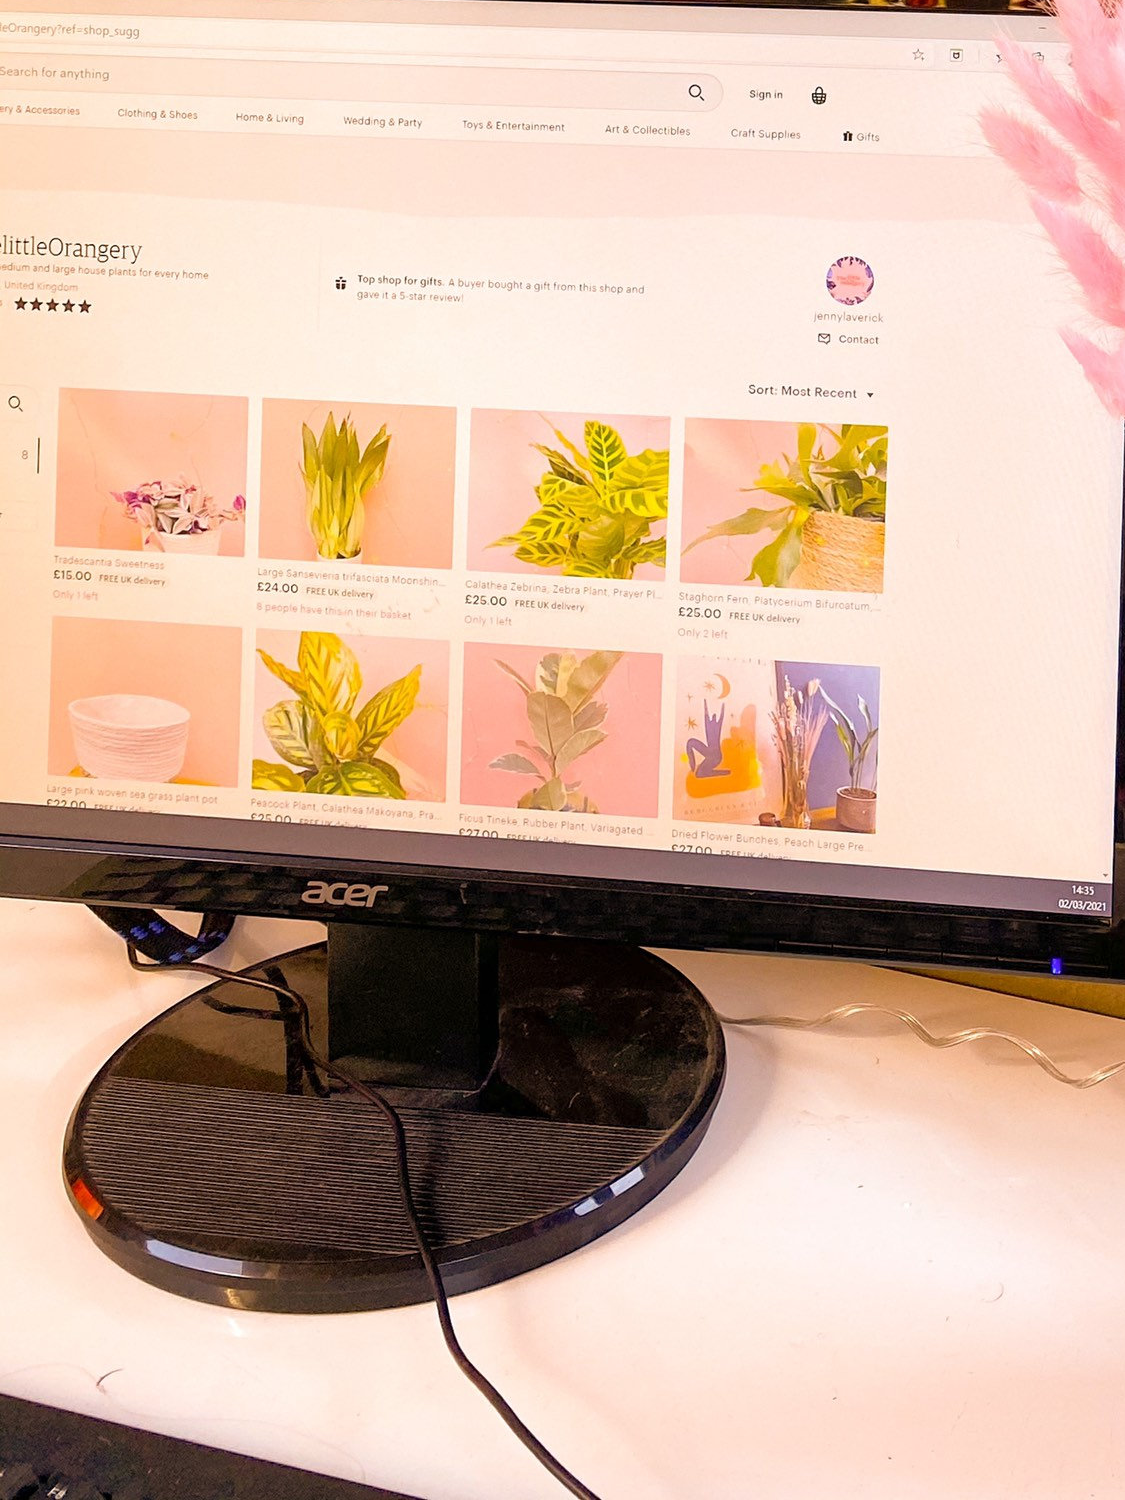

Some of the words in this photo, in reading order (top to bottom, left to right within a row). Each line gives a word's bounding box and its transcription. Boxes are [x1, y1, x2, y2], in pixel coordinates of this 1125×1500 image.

[0, 66, 38, 77] Search
[41, 67, 57, 78] for
[60, 68, 110, 81] anything
[749, 89, 772, 100] Sign
[774, 89, 784, 99] in
[16, 105, 22, 114] &
[25, 105, 80, 116] Accessories
[117, 108, 158, 121] Clothing
[160, 110, 167, 119] &
[169, 110, 199, 120] Shoes
[235, 112, 265, 122] Home
[266, 113, 273, 122] &
[276, 114, 305, 126] Living
[343, 116, 386, 128] Wedding
[388, 118, 395, 127] &
[398, 118, 423, 129] Party
[463, 120, 484, 131] Toys
[486, 121, 493, 131] &
[496, 121, 566, 132] Entertainment
[605, 124, 620, 134] Art
[622, 125, 629, 134] &
[632, 124, 691, 136] Collectibles
[731, 128, 756, 139] Craft
[758, 129, 801, 141] Supplies
[857, 132, 881, 143] Gifts
[0, 235, 143, 264] littleOrangery
[33, 263, 50, 273] and
[52, 263, 76, 275] large
[78, 265, 106, 275] house
[108, 267, 137, 278] plants
[139, 268, 152, 277] for
[154, 270, 180, 280] every
[182, 269, 210, 280] home
[4, 280, 35, 291] United
[37, 282, 79, 293] Kingdom
[358, 274, 376, 286] Top
[377, 275, 402, 286] shop
[404, 276, 418, 286] for
[448, 278, 456, 287] A
[458, 278, 485, 289] buyer
[488, 280, 523, 292] bought
[526, 282, 532, 290] a
[534, 282, 551, 292] gift
[553, 282, 576, 292] from
[579, 283, 597, 293] this
[599, 284, 624, 295] shop
[626, 285, 645, 295] and
[357, 291, 380, 301] gave
[382, 291, 389, 300] it
[391, 292, 397, 300] a
[399, 291, 427, 301] 5-star
[813, 311, 885, 323] jennylaverick
[838, 334, 880, 345] Contact
[748, 384, 778, 396] Sort:
[781, 385, 811, 397] Most
[814, 387, 857, 399] Recent
[53, 555, 113, 567] Tradescantia
[114, 558, 165, 570] Sweetness
[53, 569, 93, 581] £15.00
[257, 567, 284, 579] Large
[342, 572, 390, 583] trifasciata
[256, 582, 299, 595] £24.00
[306, 586, 326, 596] FREE
[328, 588, 340, 597] UK
[341, 589, 375, 600] delivery
[465, 579, 508, 591] Calathea
[552, 584, 581, 595] Zebra
[613, 588, 644, 599] Prayer
[464, 594, 508, 607] £25.00
[514, 599, 536, 609] FREE
[537, 600, 550, 609] UK
[551, 601, 585, 612] delivery
[678, 591, 724, 604] Staghorn
[754, 597, 813, 609] Platycerium
[677, 606, 722, 619] £25.00
[729, 611, 750, 621] FREE
[752, 613, 765, 622] UK
[767, 614, 801, 624] delivery
[677, 627, 700, 638] Only
[711, 630, 728, 639] left
[46, 784, 73, 796] Large
[74, 786, 95, 796] pink
[97, 788, 127, 799] woven
[130, 791, 146, 800] sea
[148, 792, 173, 802] grass
[175, 793, 200, 803] plant
[202, 795, 218, 804] pot
[250, 797, 290, 809] Peacock
[321, 803, 364, 815] Calathea
[458, 813, 484, 824] Ficus
[522, 817, 558, 828] Rubber
[591, 822, 643, 836] Variagated
[671, 828, 698, 840] Dried
[700, 830, 733, 842] Flower
[784, 836, 814, 849] Peach
[817, 839, 846, 852] Large
[301, 880, 389, 908] acer
[1071, 884, 1095, 896] 14:35
[1058, 898, 1107, 912] 02/03/2021
